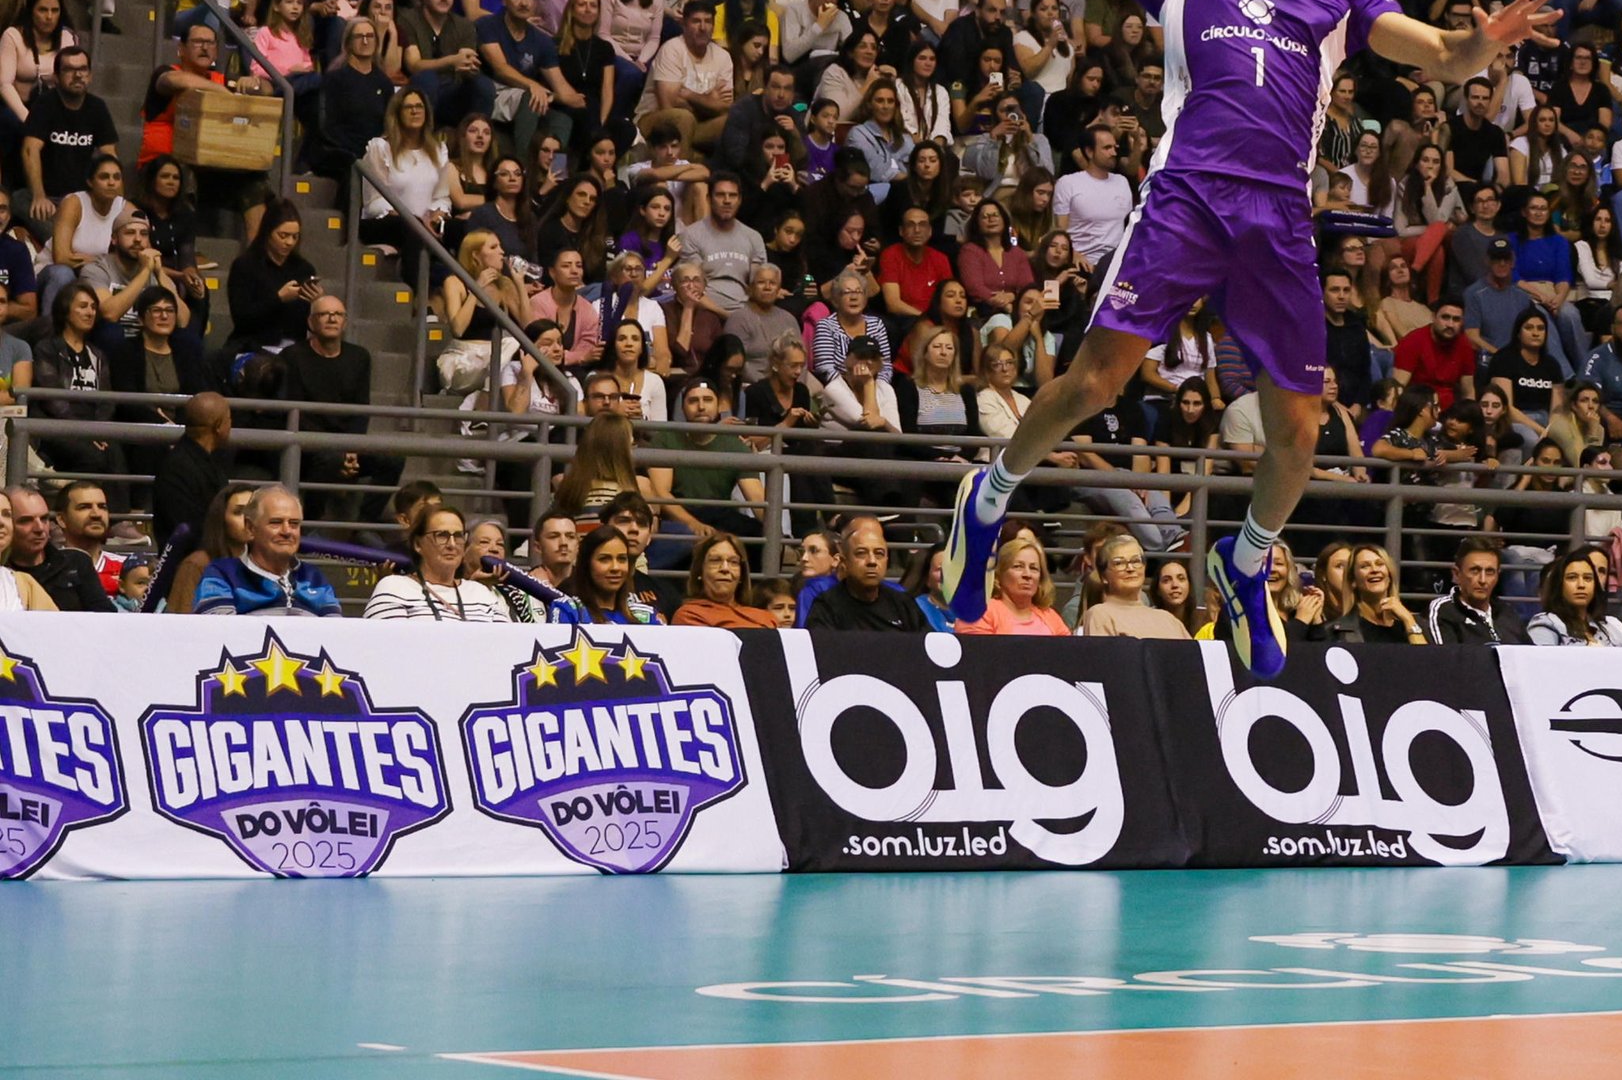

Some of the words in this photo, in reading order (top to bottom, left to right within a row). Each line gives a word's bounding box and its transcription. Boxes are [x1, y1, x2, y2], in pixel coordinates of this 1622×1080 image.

[1250, 46, 1266, 87] 1
[50, 130, 94, 147] adidas
[0, 705, 115, 806] TES
[153, 719, 437, 810] GIGANTES
[472, 698, 735, 805] GIGANTES
[779, 628, 1125, 866] big
[1197, 639, 1510, 867] big
[235, 811, 282, 841] DO
[288, 801, 379, 839] VÔLEI
[551, 797, 594, 827] DO
[595, 784, 681, 817] VÔLEI
[272, 840, 356, 869] 2025
[585, 820, 662, 855] 2025
[842, 825, 1008, 859] .som.luz.led
[1262, 827, 1408, 861] .som.luz.led
